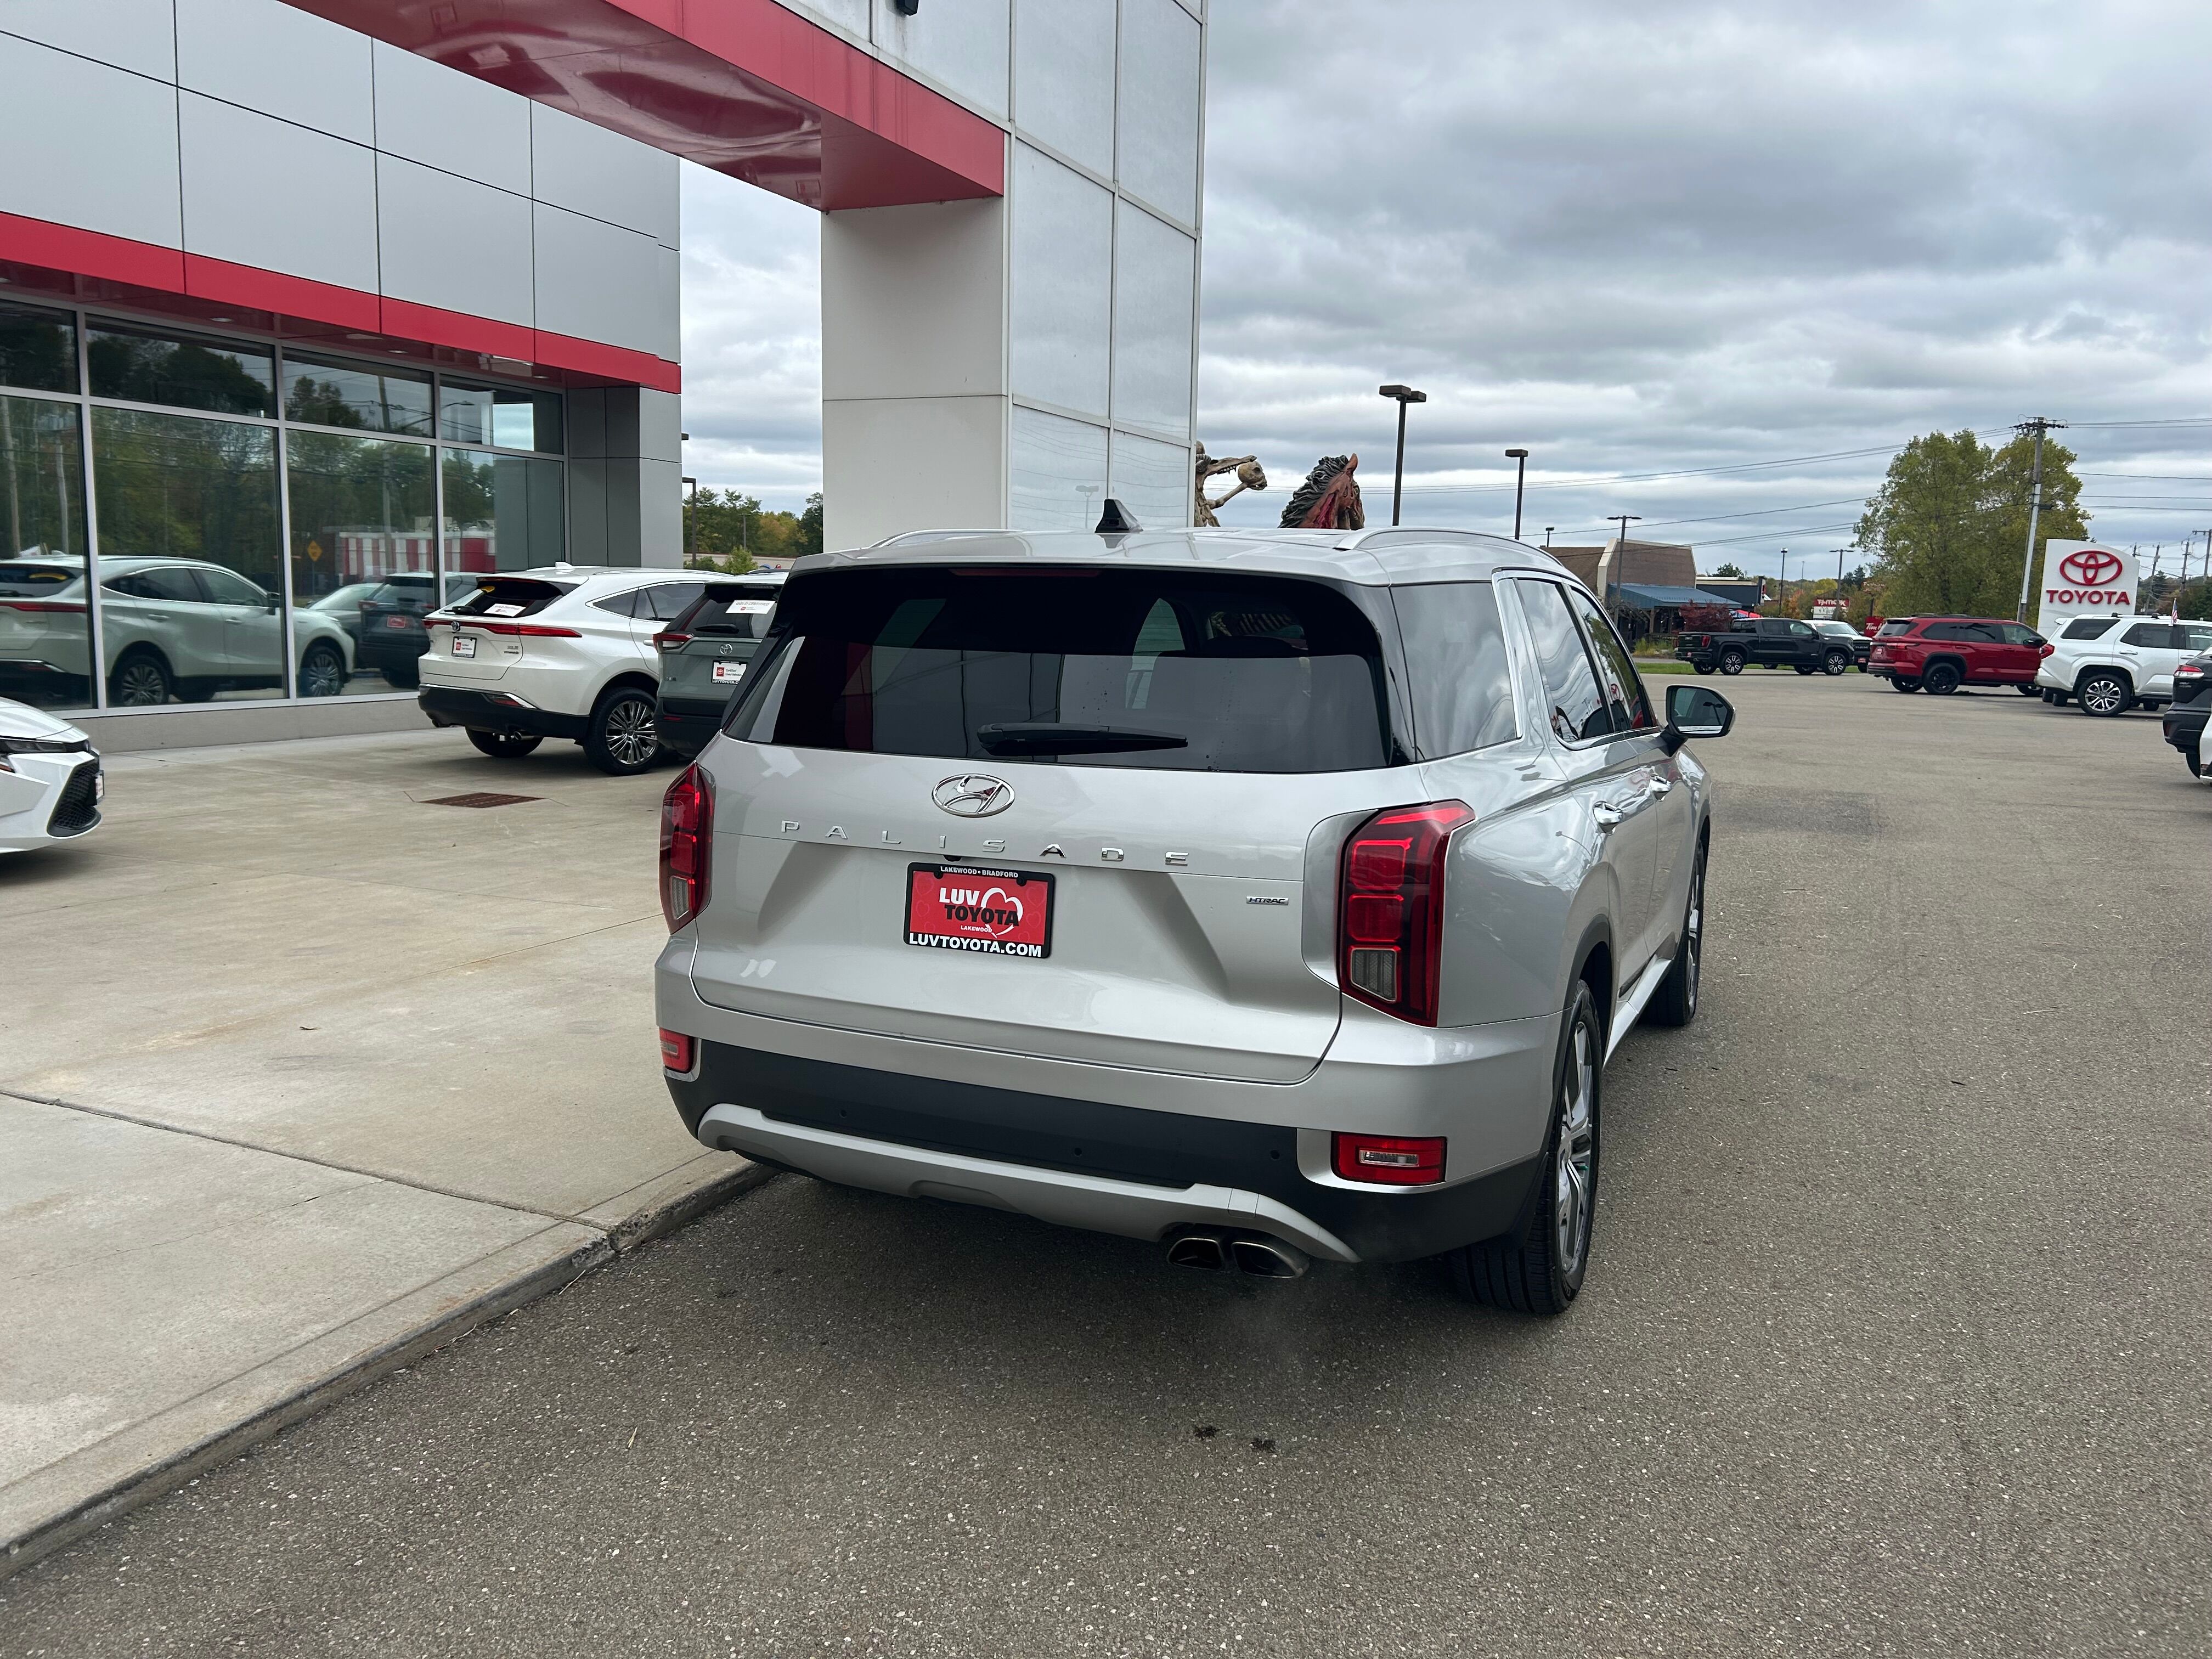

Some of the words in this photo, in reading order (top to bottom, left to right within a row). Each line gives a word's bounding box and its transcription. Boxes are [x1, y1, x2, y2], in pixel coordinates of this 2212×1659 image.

[2046, 590, 2130, 605] TOYOTA
[781, 820, 1189, 866] PALISADE
[940, 866, 977, 874] LAKEWOOD
[982, 870, 1018, 878] BRADFORD
[939, 887, 980, 906] LUV
[945, 904, 1019, 927] TOYOTA
[909, 933, 1042, 957] LUVTOYOTA.COM
